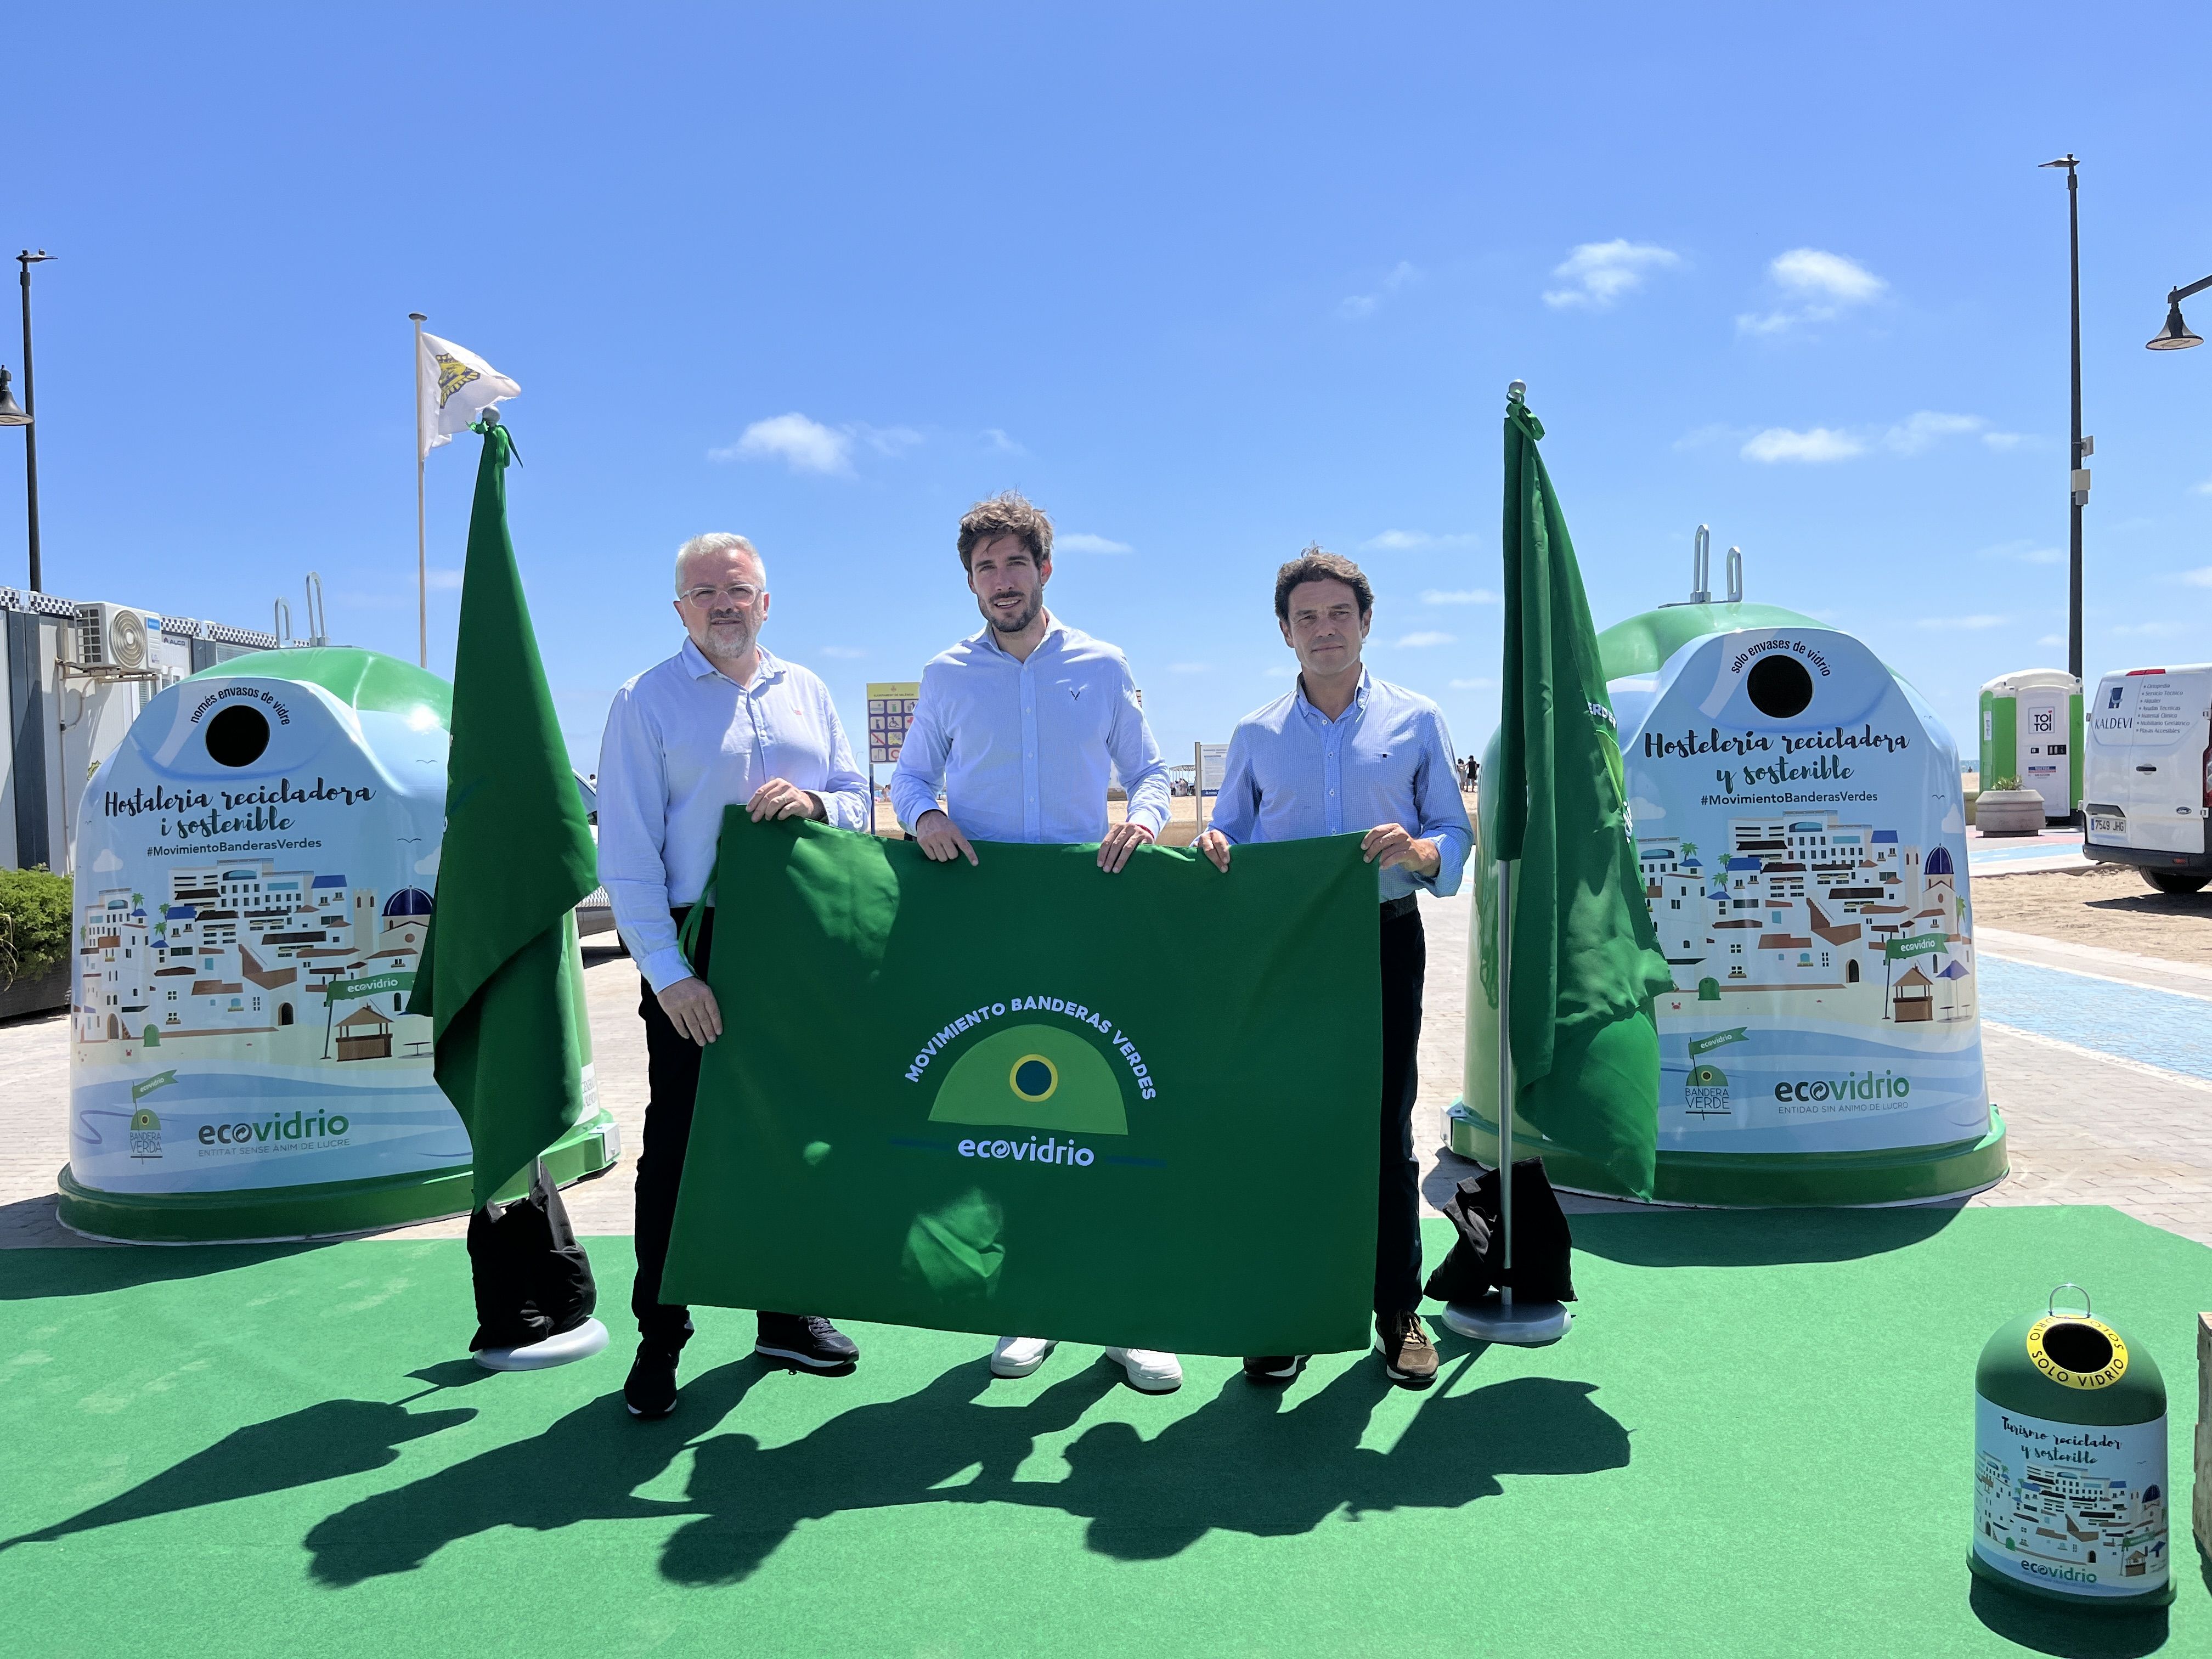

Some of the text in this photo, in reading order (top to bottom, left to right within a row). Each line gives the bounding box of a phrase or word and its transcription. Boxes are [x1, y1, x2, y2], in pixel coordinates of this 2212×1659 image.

[1731, 640, 1831, 677] solo envases de vidrio
[190, 687, 290, 725] només envasos de vidre
[2034, 714, 2051, 723] TOI
[2034, 723, 2051, 731] TOI
[2095, 717, 2132, 729] KALDEVI
[1645, 724, 1910, 758] Hostelería recicladora
[1716, 754, 1855, 794] y sostenible
[105, 777, 376, 817] Hostaleria recicladora
[1701, 791, 1878, 806] #MovimientoBanderasVerdes
[161, 805, 296, 839] i sostenible
[2095, 820, 2124, 832] 7549 JHG
[146, 837, 323, 857] #MovimientoBanderasVerdes
[1900, 938, 1936, 952] ecovidrio
[347, 978, 398, 993] ecovidrio
[905, 996, 1156, 1101] MOVIMIENTO BANDERAS VERDES
[1700, 1034, 1733, 1048] ecovidrio
[140, 1077, 165, 1093] ecovidrio
[1685, 1088, 1729, 1097] BANDERA
[1774, 1069, 1910, 1102] ecovidrio
[1685, 1097, 1730, 1109] VERDE
[1778, 1105, 1819, 1114] ENTIDAD
[1869, 1103, 1880, 1111] DE
[1882, 1101, 1909, 1110] LUCRO
[129, 1132, 162, 1141] BANDERA
[198, 1108, 350, 1146] ecovidrio
[129, 1141, 162, 1154] VERDA
[198, 1148, 236, 1158] ENTITAT
[239, 1145, 270, 1155] SENSE
[301, 1141, 314, 1150] DE
[317, 1138, 351, 1149] LUCRE
[958, 1135, 1094, 1166] ecovidrio
[2032, 1351, 2124, 1387] SOLO VIDRIO
[2001, 1416, 2123, 1450] Turismo reciclador
[2021, 1444, 2099, 1464] y sostenible
[2021, 1560, 2097, 1583] ecovidrio
